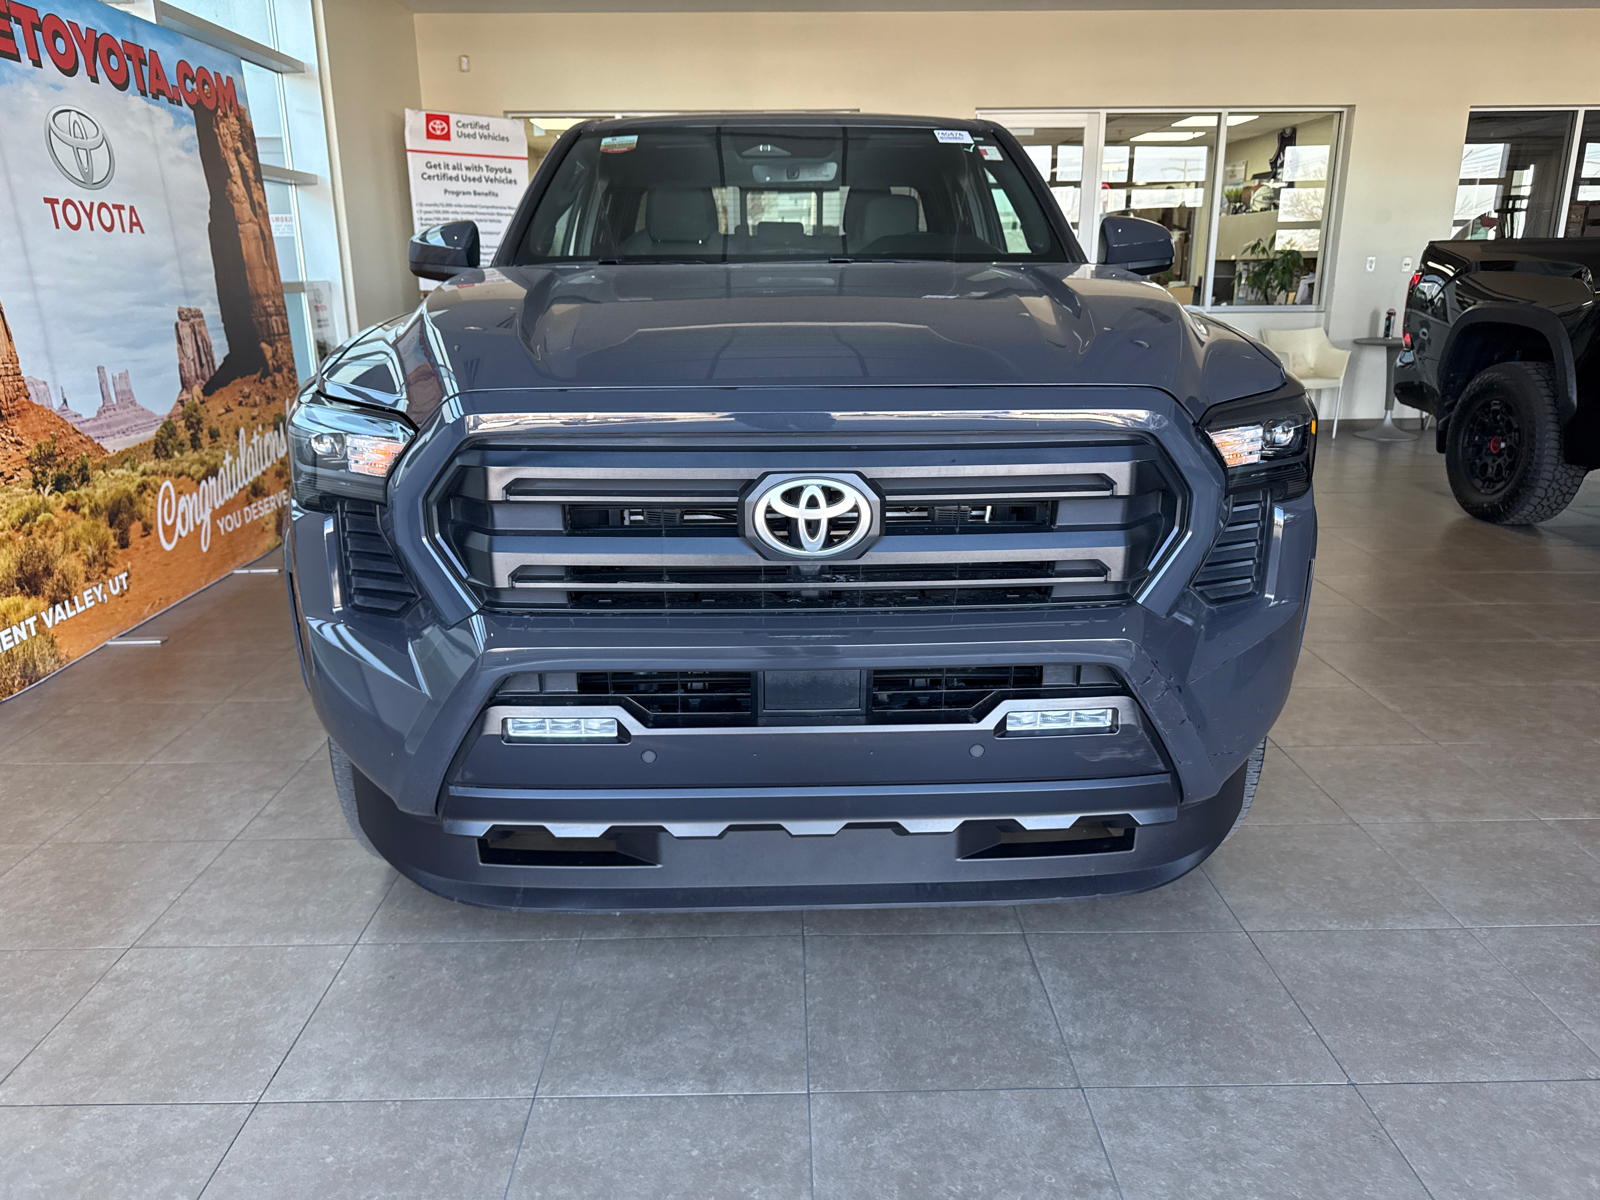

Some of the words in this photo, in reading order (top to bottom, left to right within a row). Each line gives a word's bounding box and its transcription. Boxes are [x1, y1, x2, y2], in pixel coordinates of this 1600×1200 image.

[456, 120, 490, 131] Certified
[456, 130, 477, 140] Used
[478, 131, 510, 143] Vehicles
[425, 160, 442, 170] Get
[443, 161, 450, 171] it
[451, 162, 463, 171] all
[464, 162, 484, 173] with
[485, 164, 512, 175] Toyota
[421, 171, 460, 182] Certified
[461, 173, 483, 183] Used
[484, 175, 518, 186] Vehicles
[443, 188, 472, 198] Program
[473, 189, 499, 198] Benefits
[43, 196, 146, 235] TOYOTA
[216, 509, 242, 536] YOU
[243, 488, 290, 524] DESERVE
[0, 615, 38, 654] ENT
[40, 582, 108, 629] VALLEY,
[108, 571, 128, 596] UT
